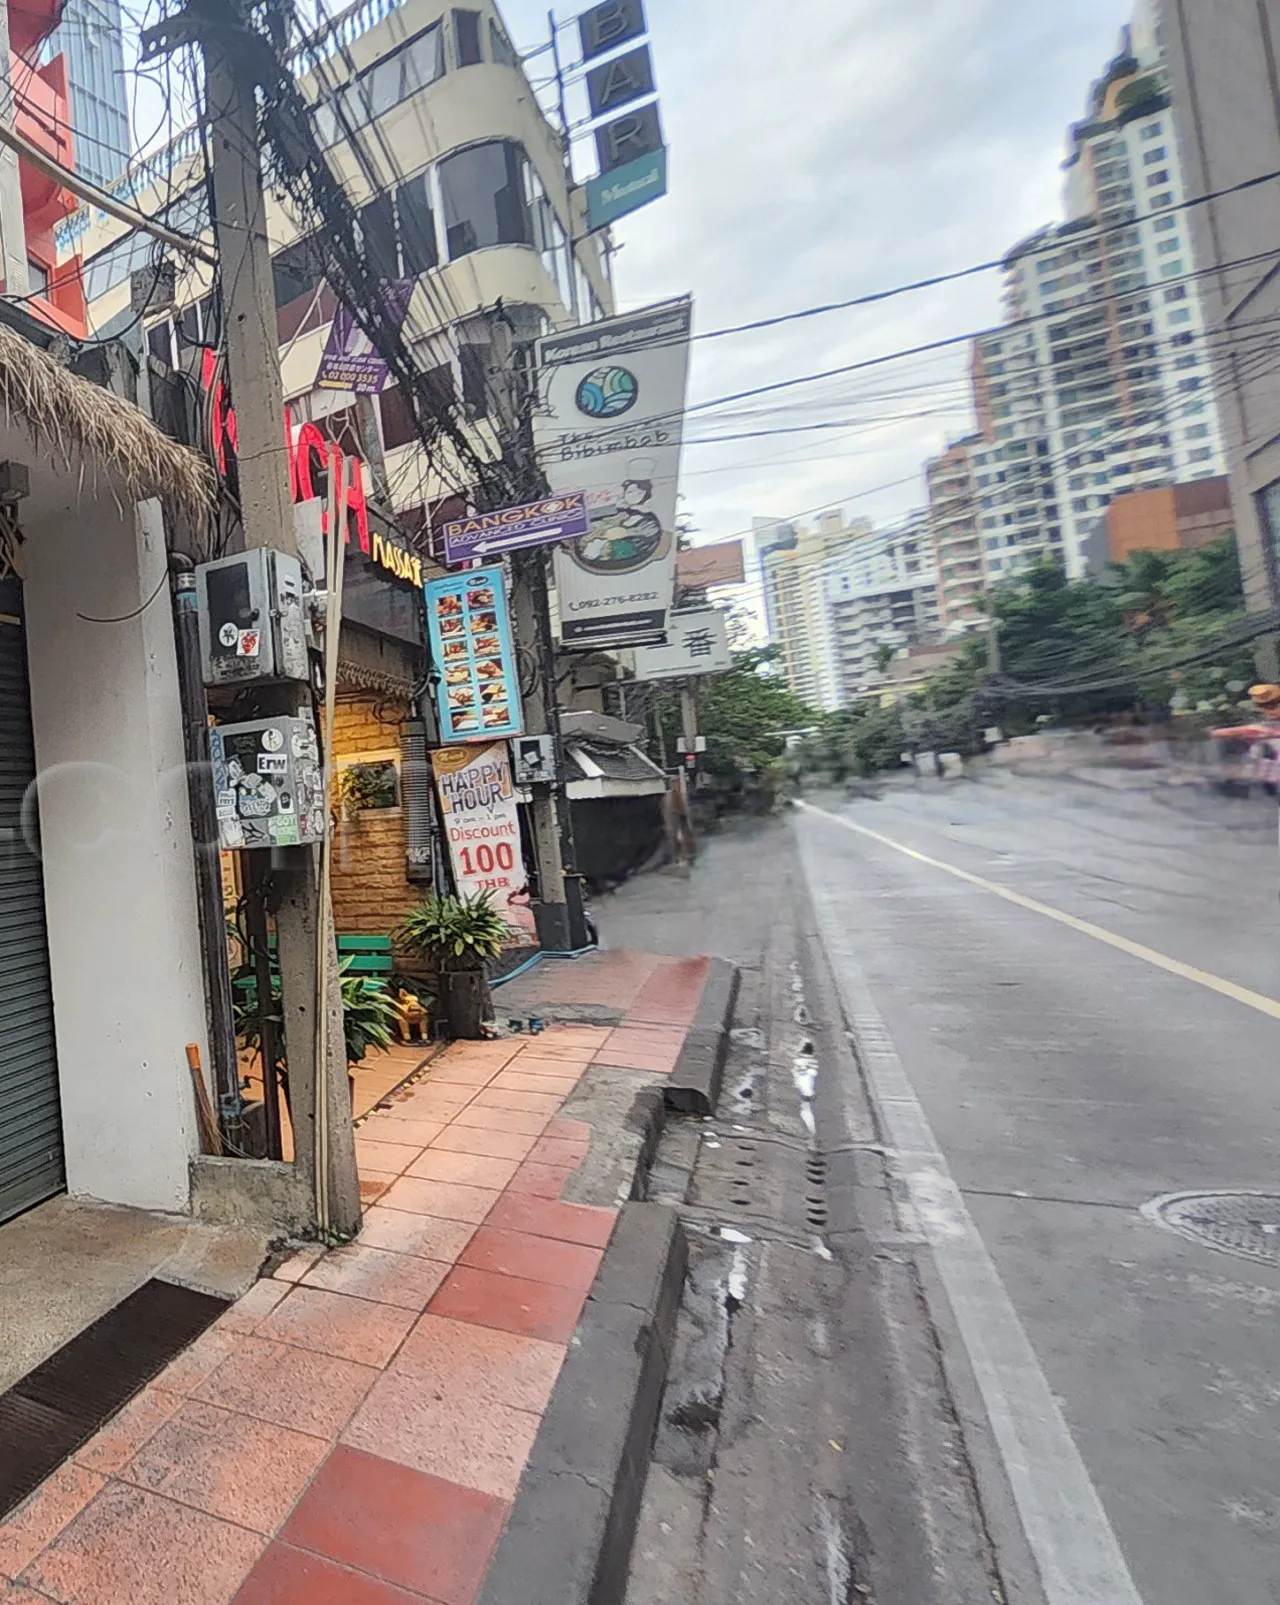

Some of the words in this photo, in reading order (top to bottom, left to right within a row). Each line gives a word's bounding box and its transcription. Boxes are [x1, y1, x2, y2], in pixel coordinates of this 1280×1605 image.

[448, 495, 582, 536] BANGKOK
[440, 760, 504, 796] HAPPY
[452, 782, 505, 814] HOUR
[450, 820, 516, 842] Discount
[459, 841, 514, 876] 100
[475, 876, 510, 890] THB
